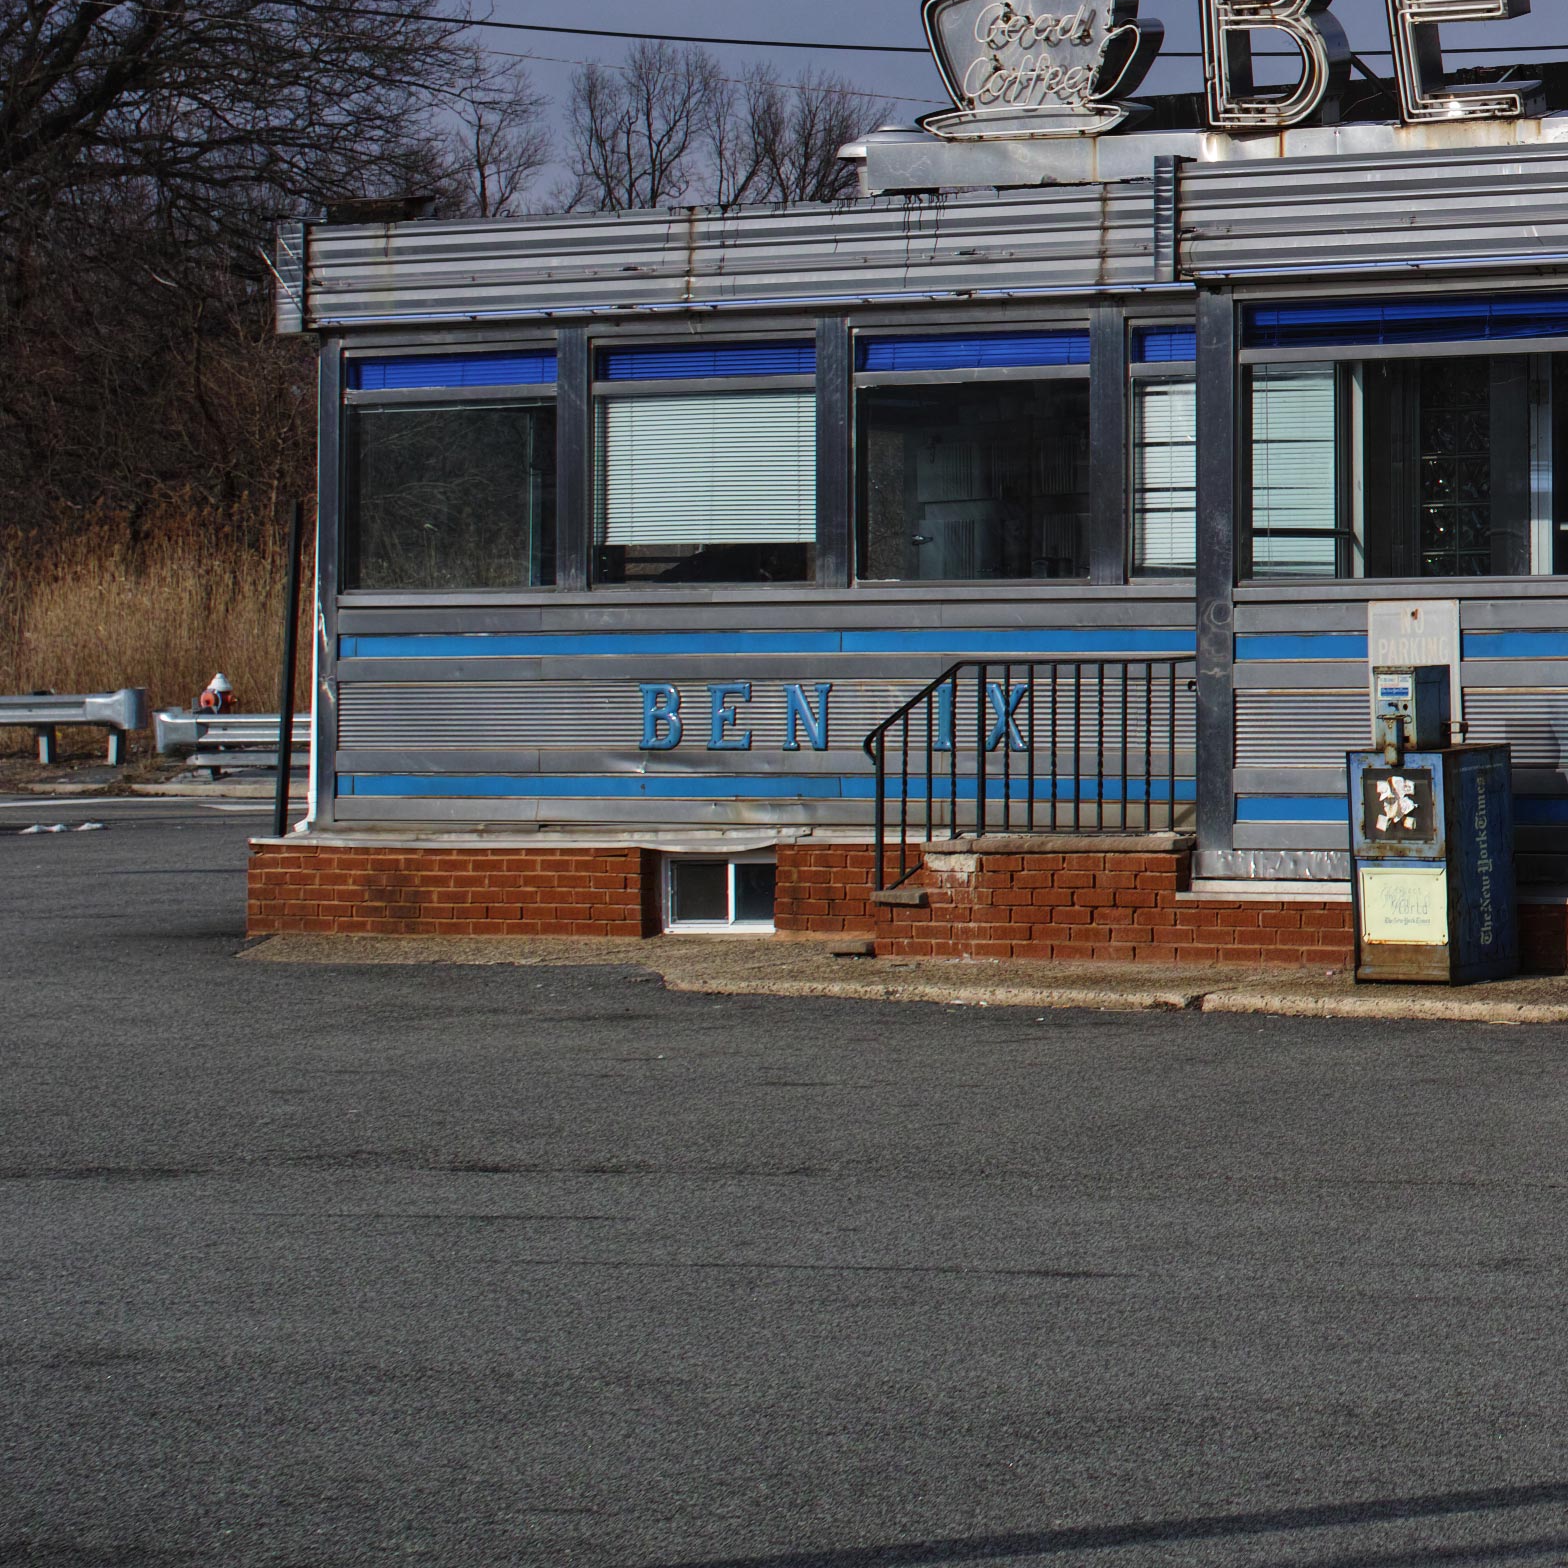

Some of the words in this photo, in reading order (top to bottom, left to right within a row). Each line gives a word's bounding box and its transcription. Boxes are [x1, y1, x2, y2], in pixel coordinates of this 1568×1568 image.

[975, 3, 1090, 44] Good
[963, 54, 1100, 107] Coffee
[1400, 607, 1425, 634] NO
[1379, 636, 1449, 665] PARKING
[1475, 776, 1488, 829] Times
[1476, 830, 1493, 874] York
[1481, 876, 1492, 911] New
[1481, 912, 1492, 945] The
